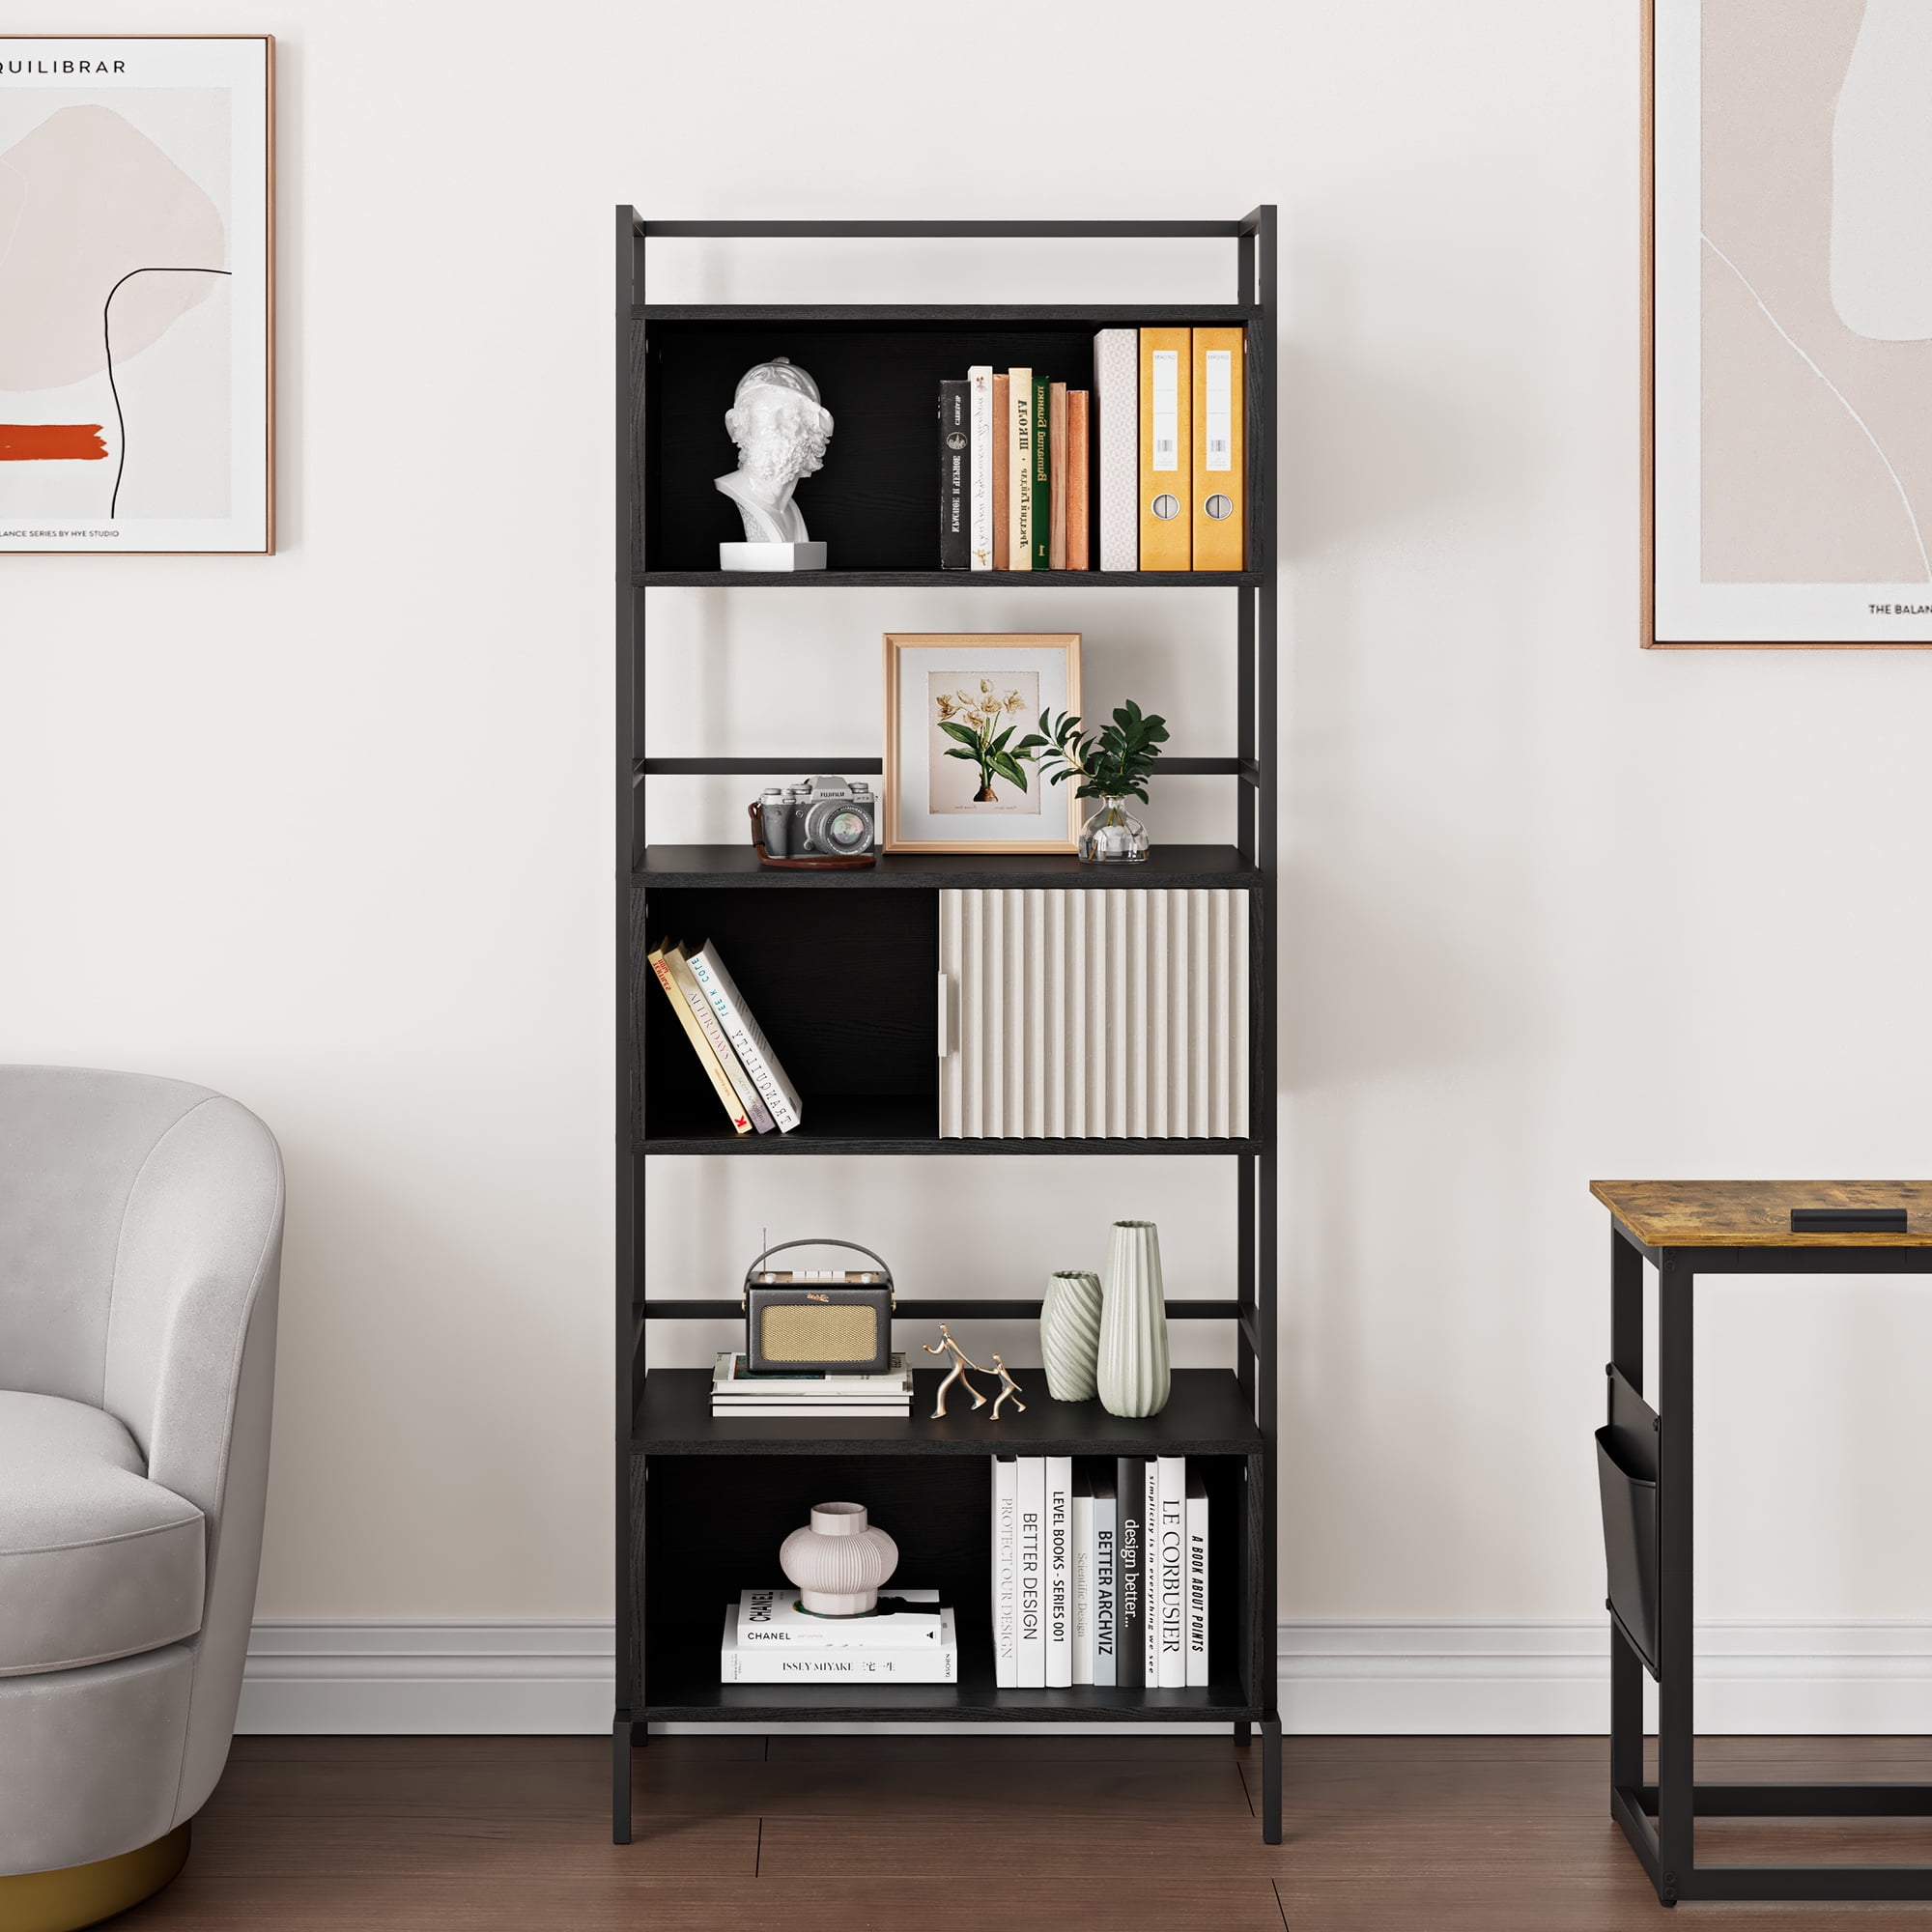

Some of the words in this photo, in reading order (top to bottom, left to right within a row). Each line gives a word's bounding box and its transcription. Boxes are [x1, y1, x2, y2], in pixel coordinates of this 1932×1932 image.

[0, 61, 126, 73] UILIBRAR
[1869, 605, 1891, 614] THE
[688, 990, 715, 1029] AFTER
[709, 1029, 733, 1061] DAYS
[1053, 1492, 1065, 1525] LEVEL
[1162, 1499, 1180, 1525] LE
[1000, 1498, 1013, 1565] PROTECT
[1023, 1513, 1037, 1571] BETTER
[1053, 1529, 1065, 1570] BOOKS
[1121, 1520, 1139, 1568] design
[1150, 1538, 1155, 1548] is
[1078, 1552, 1088, 1600] Scientific
[1098, 1531, 1113, 1585] BETTER
[1150, 1552, 1155, 1563] in
[1191, 1547, 1204, 1574] BOOK
[1000, 1568, 1013, 1601] OUR
[1053, 1579, 1065, 1618] SERIES
[1124, 1573, 1139, 1628] better...
[1162, 1531, 1180, 1654] CORBUSIER
[1191, 1577, 1204, 1611] ABOUT
[749, 1592, 773, 1622] CHANEL
[1023, 1577, 1037, 1640] DESIGN
[1077, 1603, 1088, 1637] Design
[1098, 1589, 1113, 1655] ARCHVIZ
[1000, 1605, 1013, 1659] DESIGN
[1053, 1622, 1065, 1642] 001
[1150, 1634, 1155, 1651] we
[1191, 1614, 1204, 1652] POINTS
